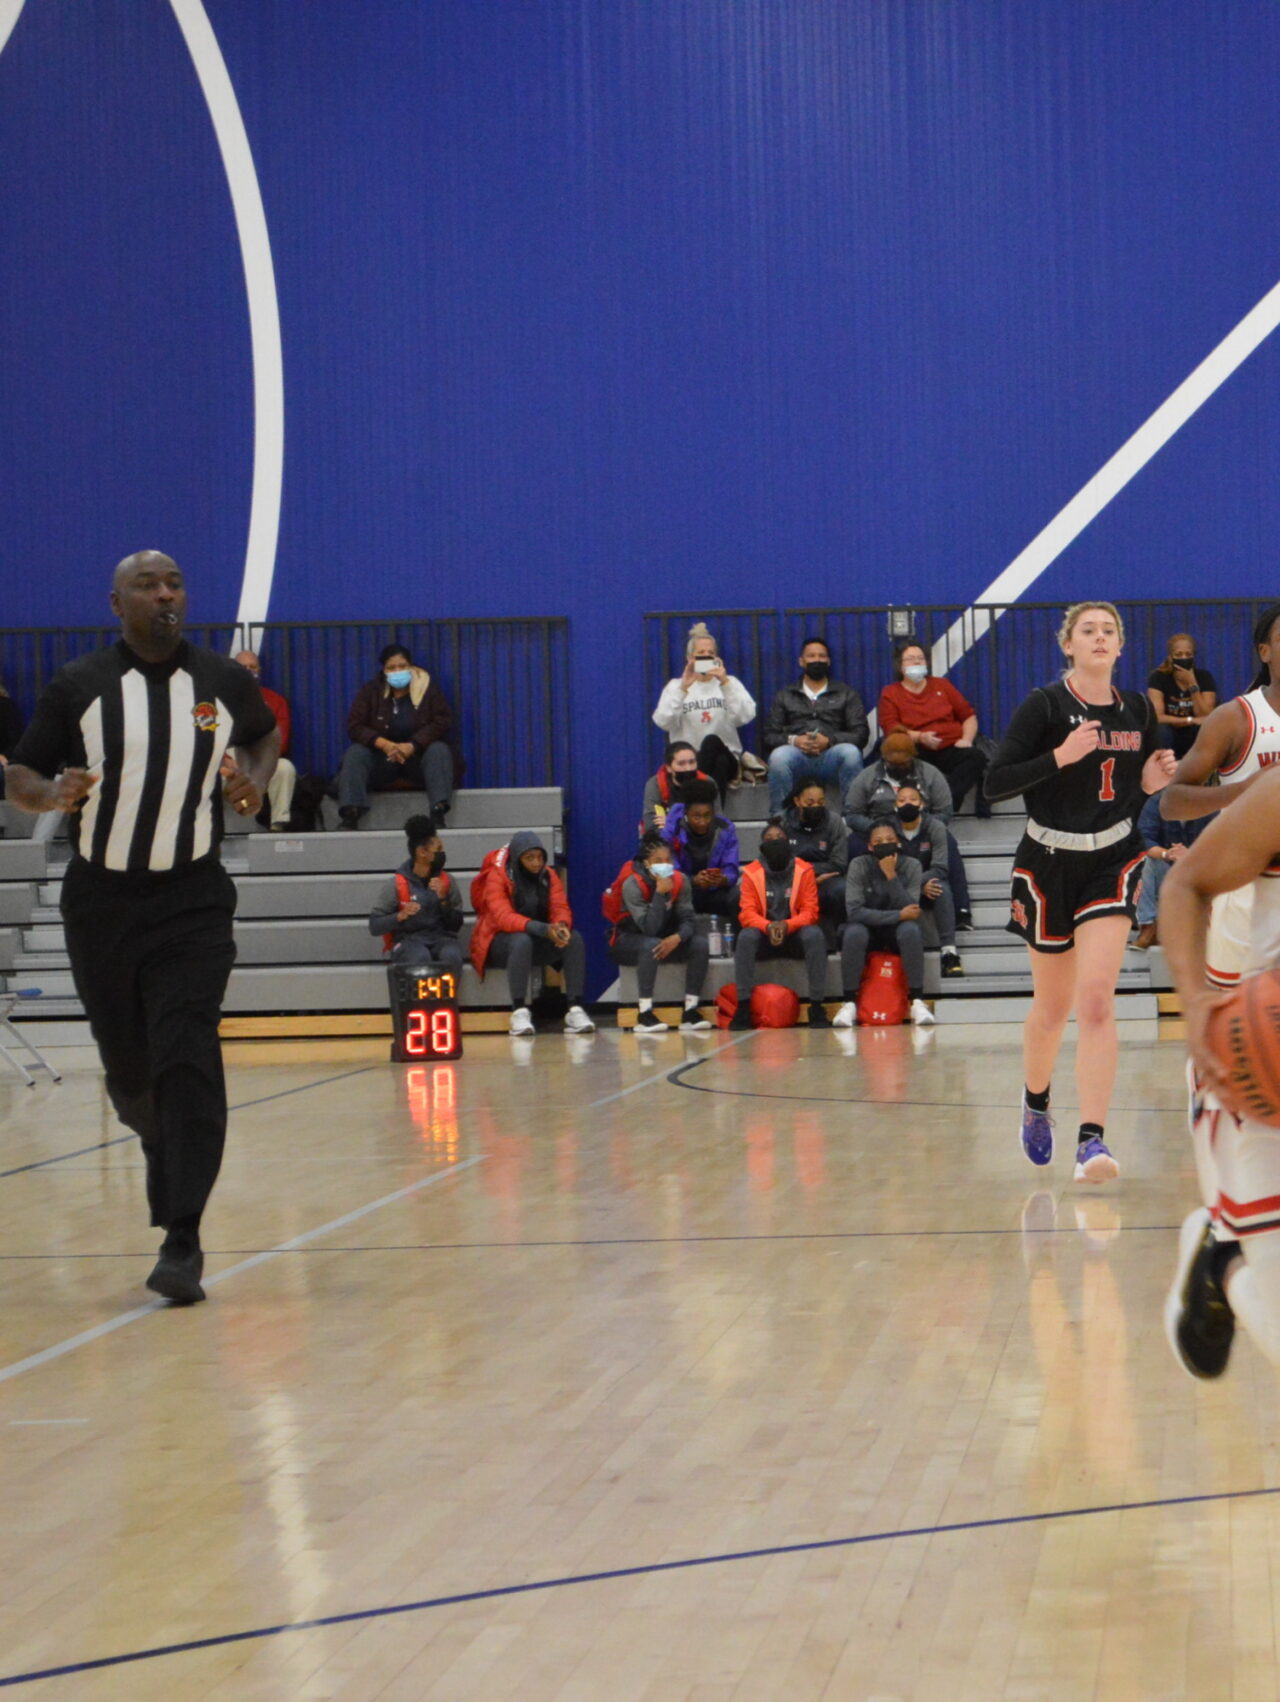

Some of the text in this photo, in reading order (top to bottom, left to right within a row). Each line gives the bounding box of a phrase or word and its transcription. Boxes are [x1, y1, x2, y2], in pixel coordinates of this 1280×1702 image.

[1099, 757, 1116, 802] 1
[418, 973, 455, 1000] 1:47
[405, 1009, 454, 1055] 28
